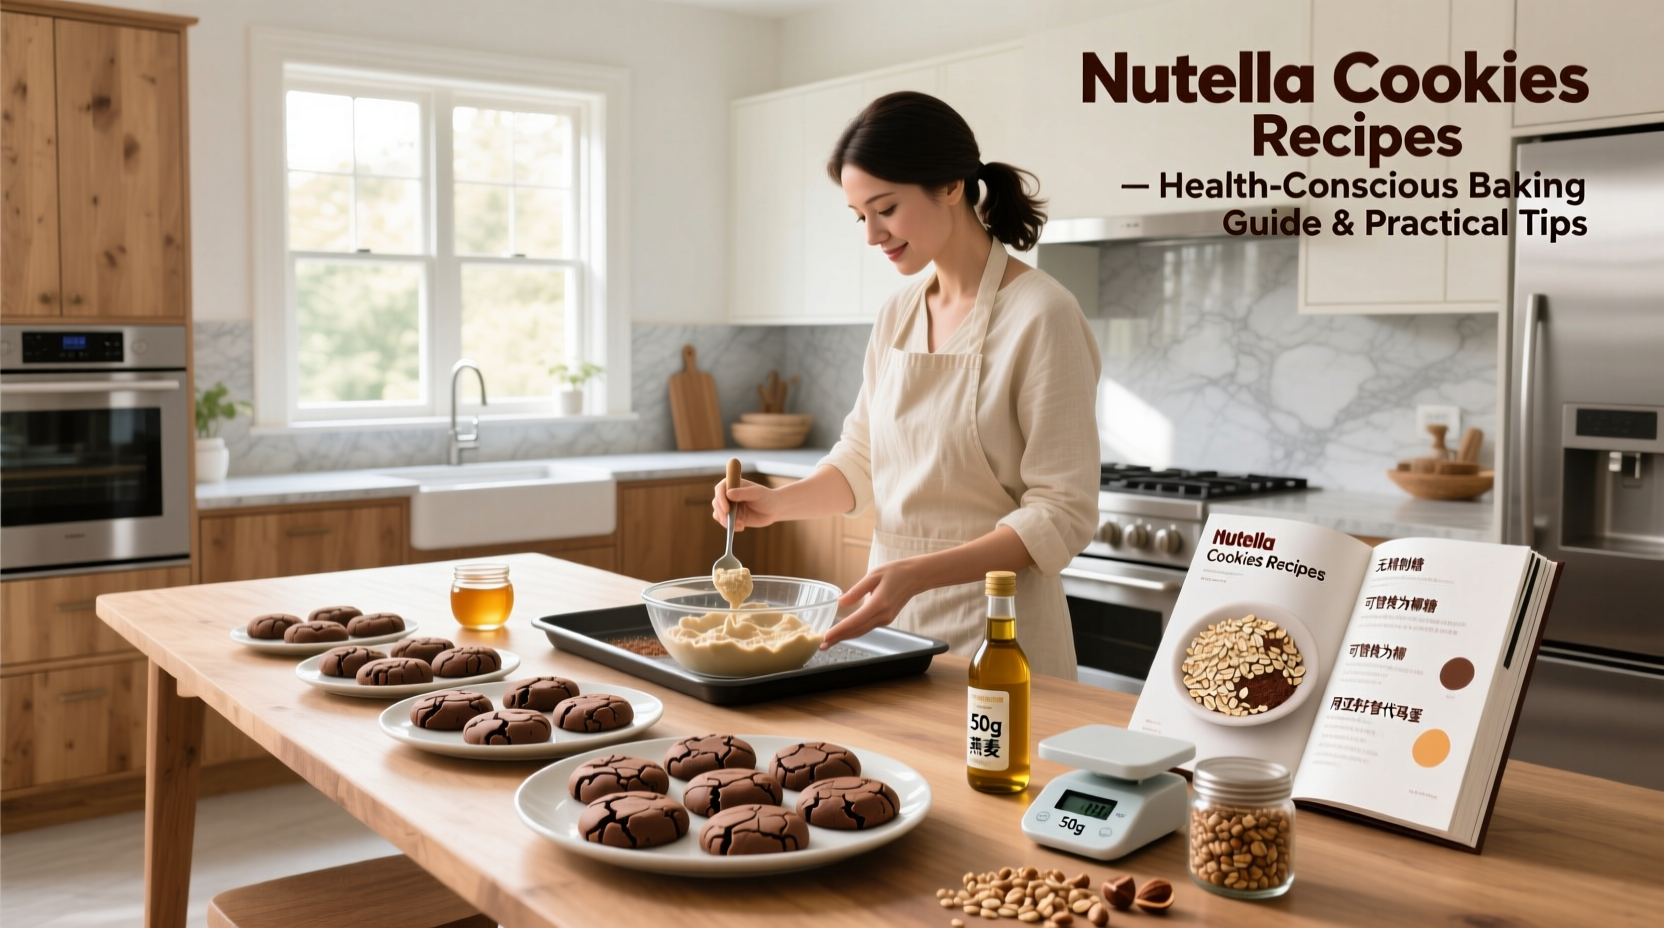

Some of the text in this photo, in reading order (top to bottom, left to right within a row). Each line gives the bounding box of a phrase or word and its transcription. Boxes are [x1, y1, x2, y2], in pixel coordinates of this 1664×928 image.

[1212, 529, 1276, 551] Nutella
[1207, 549, 1326, 582] Cookies Recipes
[971, 714, 1001, 738] 50g
[969, 736, 1001, 758] 燕麦
[1058, 816, 1086, 836] 50g
